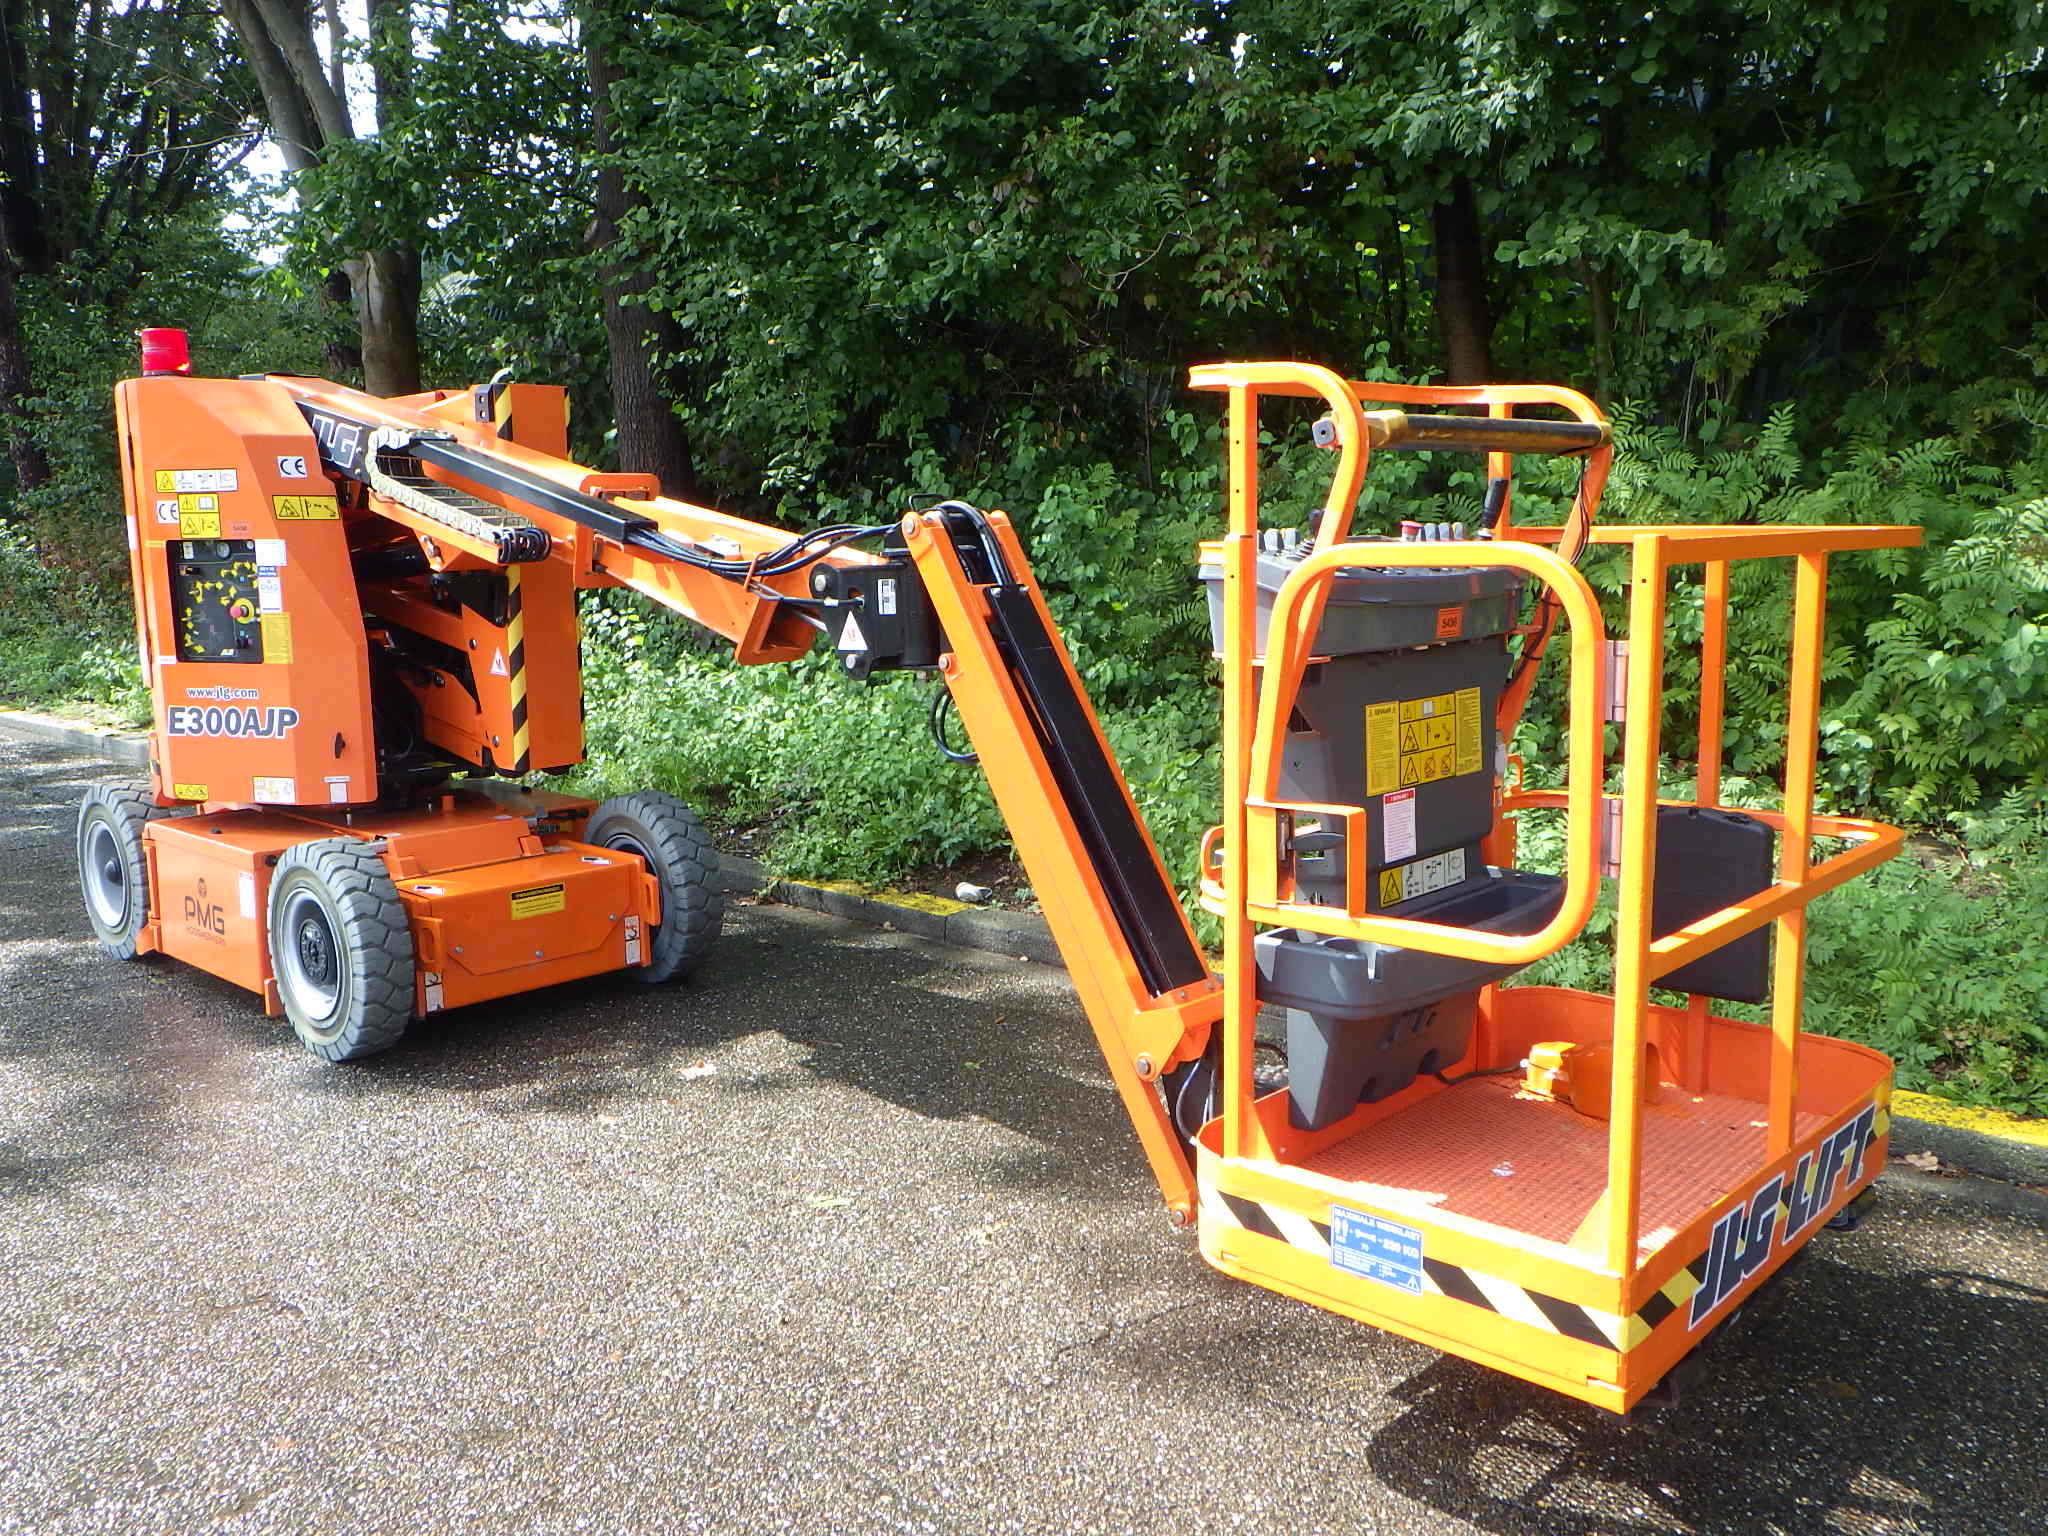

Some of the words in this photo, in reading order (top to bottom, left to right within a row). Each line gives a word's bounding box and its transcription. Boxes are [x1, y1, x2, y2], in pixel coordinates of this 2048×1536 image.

[186, 685, 259, 700] www.jlg.com
[168, 705, 300, 739] E300AJP
[184, 895, 225, 935] PMG
[1688, 1171, 1786, 1331] JLG
[1782, 1103, 1877, 1247] LIFT
